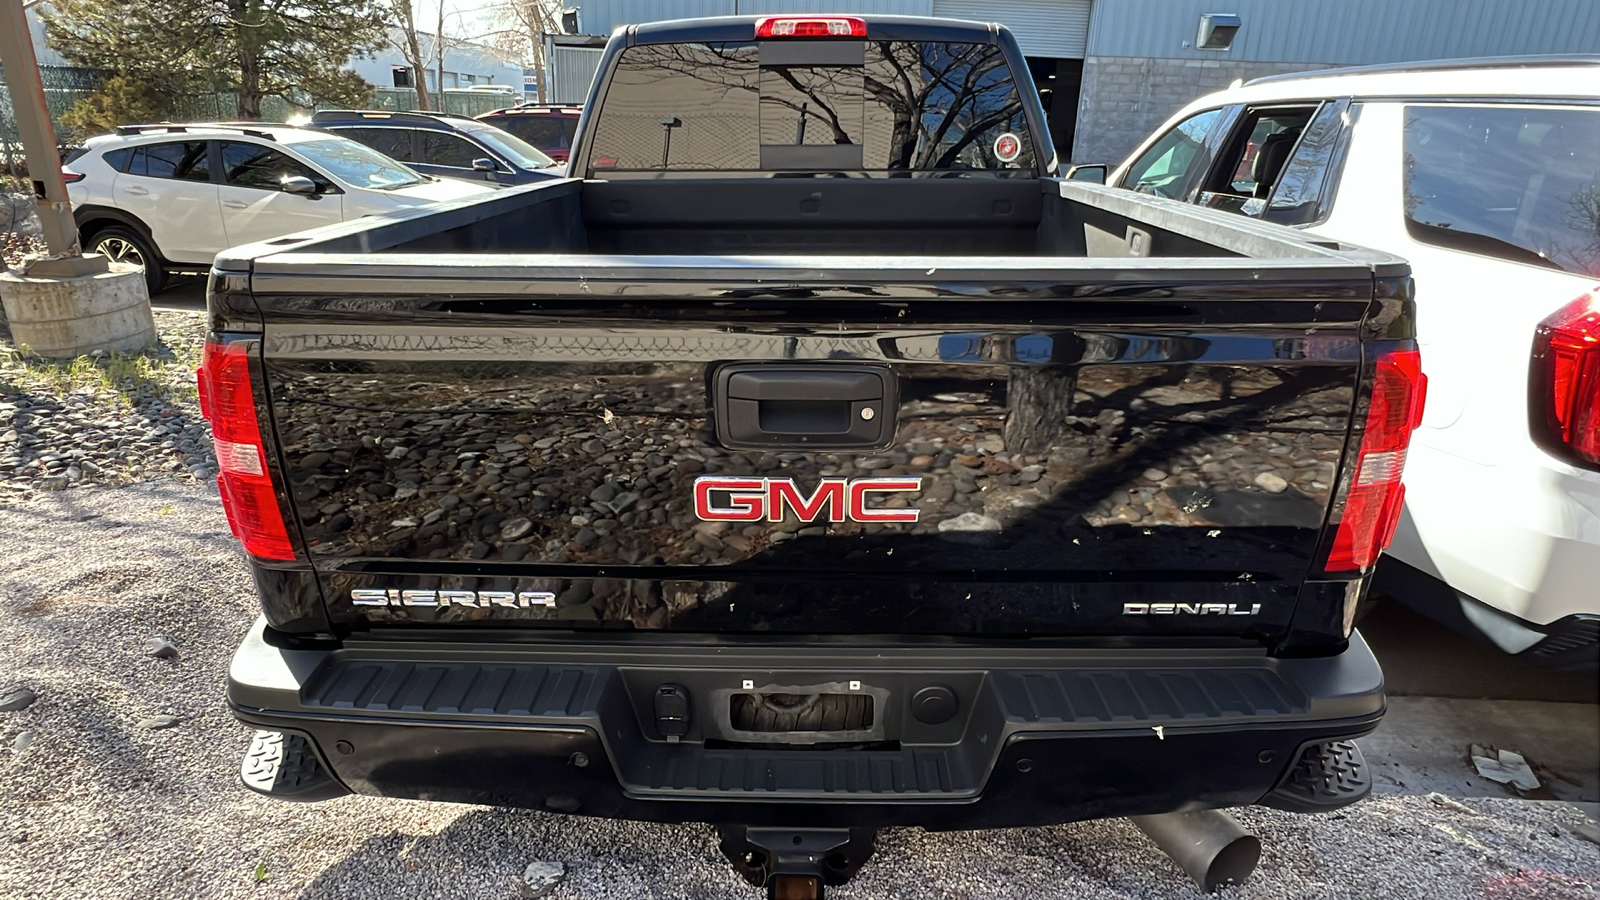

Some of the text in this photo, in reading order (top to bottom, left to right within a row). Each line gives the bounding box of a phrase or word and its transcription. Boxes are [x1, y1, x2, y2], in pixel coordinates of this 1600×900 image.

[694, 477, 922, 522] GMC
[351, 589, 556, 609] SIERRA
[1122, 603, 1261, 615] DENALI
